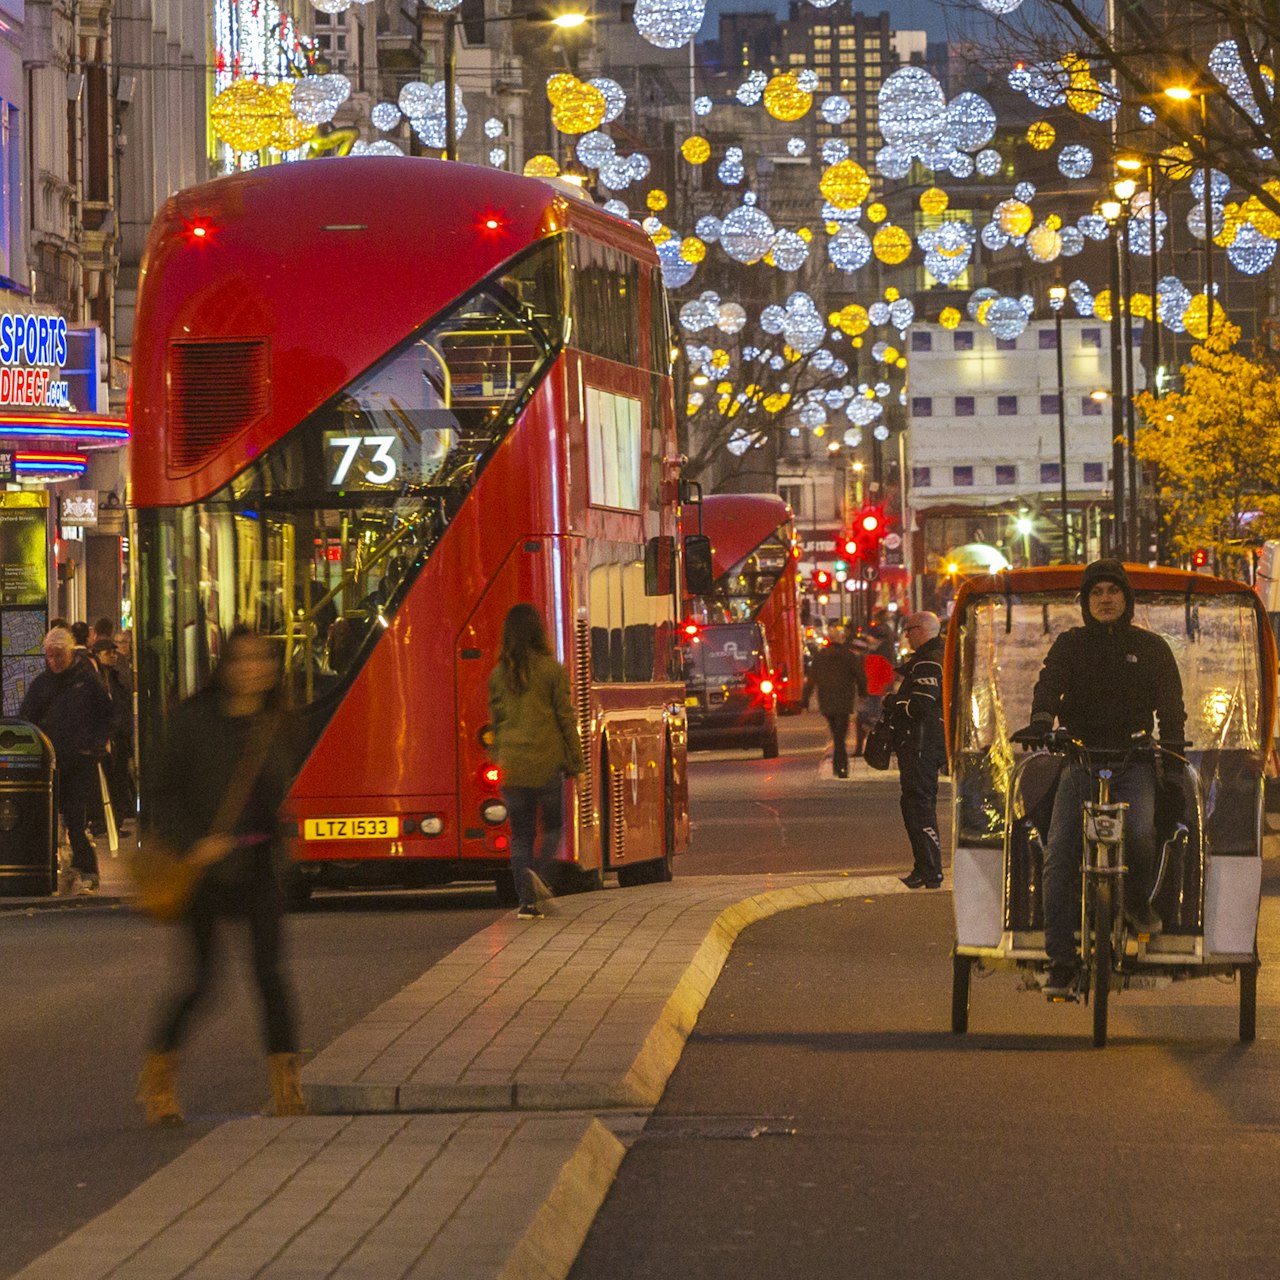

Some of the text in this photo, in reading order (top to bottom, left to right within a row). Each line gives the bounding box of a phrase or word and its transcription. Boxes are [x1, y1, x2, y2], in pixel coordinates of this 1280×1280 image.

[329, 435, 397, 486] 73
[314, 819, 389, 837] LTZ 1533
